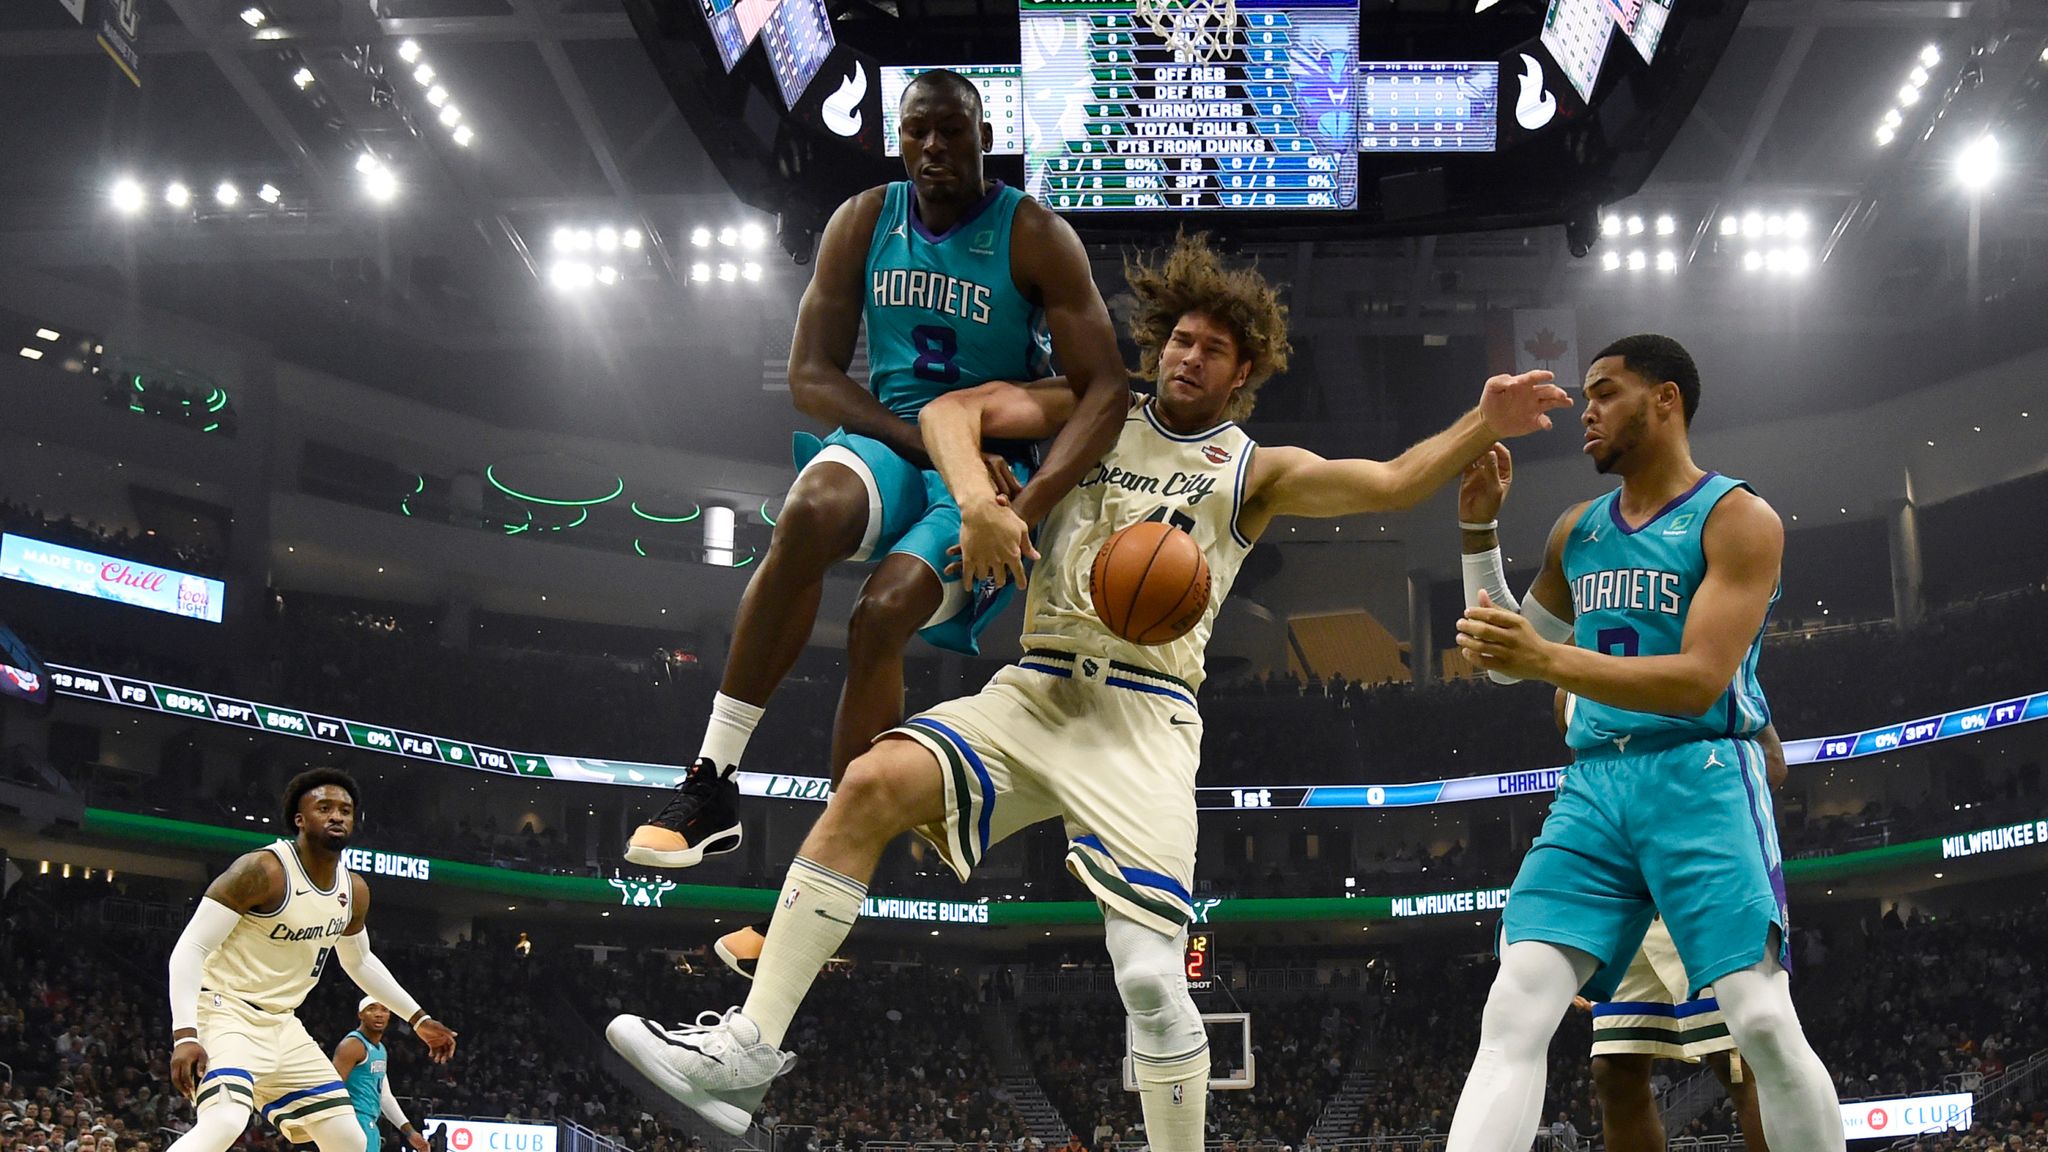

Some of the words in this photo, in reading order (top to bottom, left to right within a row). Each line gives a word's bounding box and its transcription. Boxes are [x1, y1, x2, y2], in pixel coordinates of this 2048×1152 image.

[1107, 16, 1116, 27] 2
[1264, 15, 1274, 26] 0
[1108, 33, 1118, 45] 0
[1263, 32, 1273, 43] 0
[1108, 51, 1118, 62] 0
[1264, 50, 1273, 61] 2
[1110, 69, 1117, 80] 1
[1155, 68, 1187, 81] OFF
[1191, 67, 1226, 80] REB
[1264, 69, 1274, 79] 2
[1155, 86, 1187, 99] DEF
[1191, 85, 1226, 98] REB
[1266, 87, 1273, 97] 1
[1100, 105, 1109, 116] 2
[1138, 103, 1243, 117] TURNOVERS
[1272, 104, 1282, 115] 0
[1101, 125, 1111, 135] 0
[1134, 123, 1189, 136] TOTAL
[1192, 122, 1248, 135] FOULS
[1273, 123, 1280, 134] 1
[1082, 142, 1092, 152] 0
[1117, 140, 1149, 153] PTS
[1153, 140, 1203, 153] FROM
[1206, 139, 1266, 152] DUNKS
[1291, 140, 1300, 151] 0
[1180, 158, 1203, 171] FG
[1266, 158, 1275, 169] 7
[1307, 157, 1331, 170] 0%
[1175, 176, 1207, 188] 3PT
[1307, 175, 1331, 187] 0%
[1135, 194, 1159, 207] 0%
[1181, 194, 1201, 206] FT
[1307, 193, 1330, 205] 0%
[872, 268, 992, 325] HORNETS
[911, 324, 961, 384] 8
[1161, 471, 1217, 505] City
[22, 549, 72, 571] MADE
[76, 559, 97, 575] TO
[100, 561, 168, 592] Chill
[1571, 568, 1682, 617] HORNETS
[51, 673, 73, 688] 13
[75, 678, 99, 692] PM
[122, 686, 147, 702] FG
[216, 703, 252, 721] 3PT
[267, 712, 304, 731] 50%
[317, 721, 339, 737] FT
[366, 731, 392, 748] 0%
[479, 752, 509, 769] TOL
[525, 759, 538, 772] 7
[1825, 742, 1848, 756] FG
[1875, 732, 1898, 748] 0%
[1905, 723, 1936, 741] 3PT
[1960, 714, 1985, 730] 0%
[1996, 705, 2017, 722] FT
[766, 776, 831, 799] Crea
[1231, 789, 1271, 808] 1st
[1366, 787, 1385, 805] 0
[1497, 771, 1560, 794] CHARLO
[1942, 822, 2034, 860] MILWAUKEE
[374, 852, 430, 880] BUCKS
[939, 902, 988, 923] BUCKS
[1391, 892, 1474, 917] MILWAUKEE
[269, 923, 324, 942] Cream
[1193, 936, 1206, 951] 12
[310, 947, 329, 977] 9
[1188, 952, 1203, 977] 2
[1186, 981, 1212, 989] SSOT
[1904, 1103, 1960, 1126] CLUB
[489, 1132, 544, 1151] CLUB
